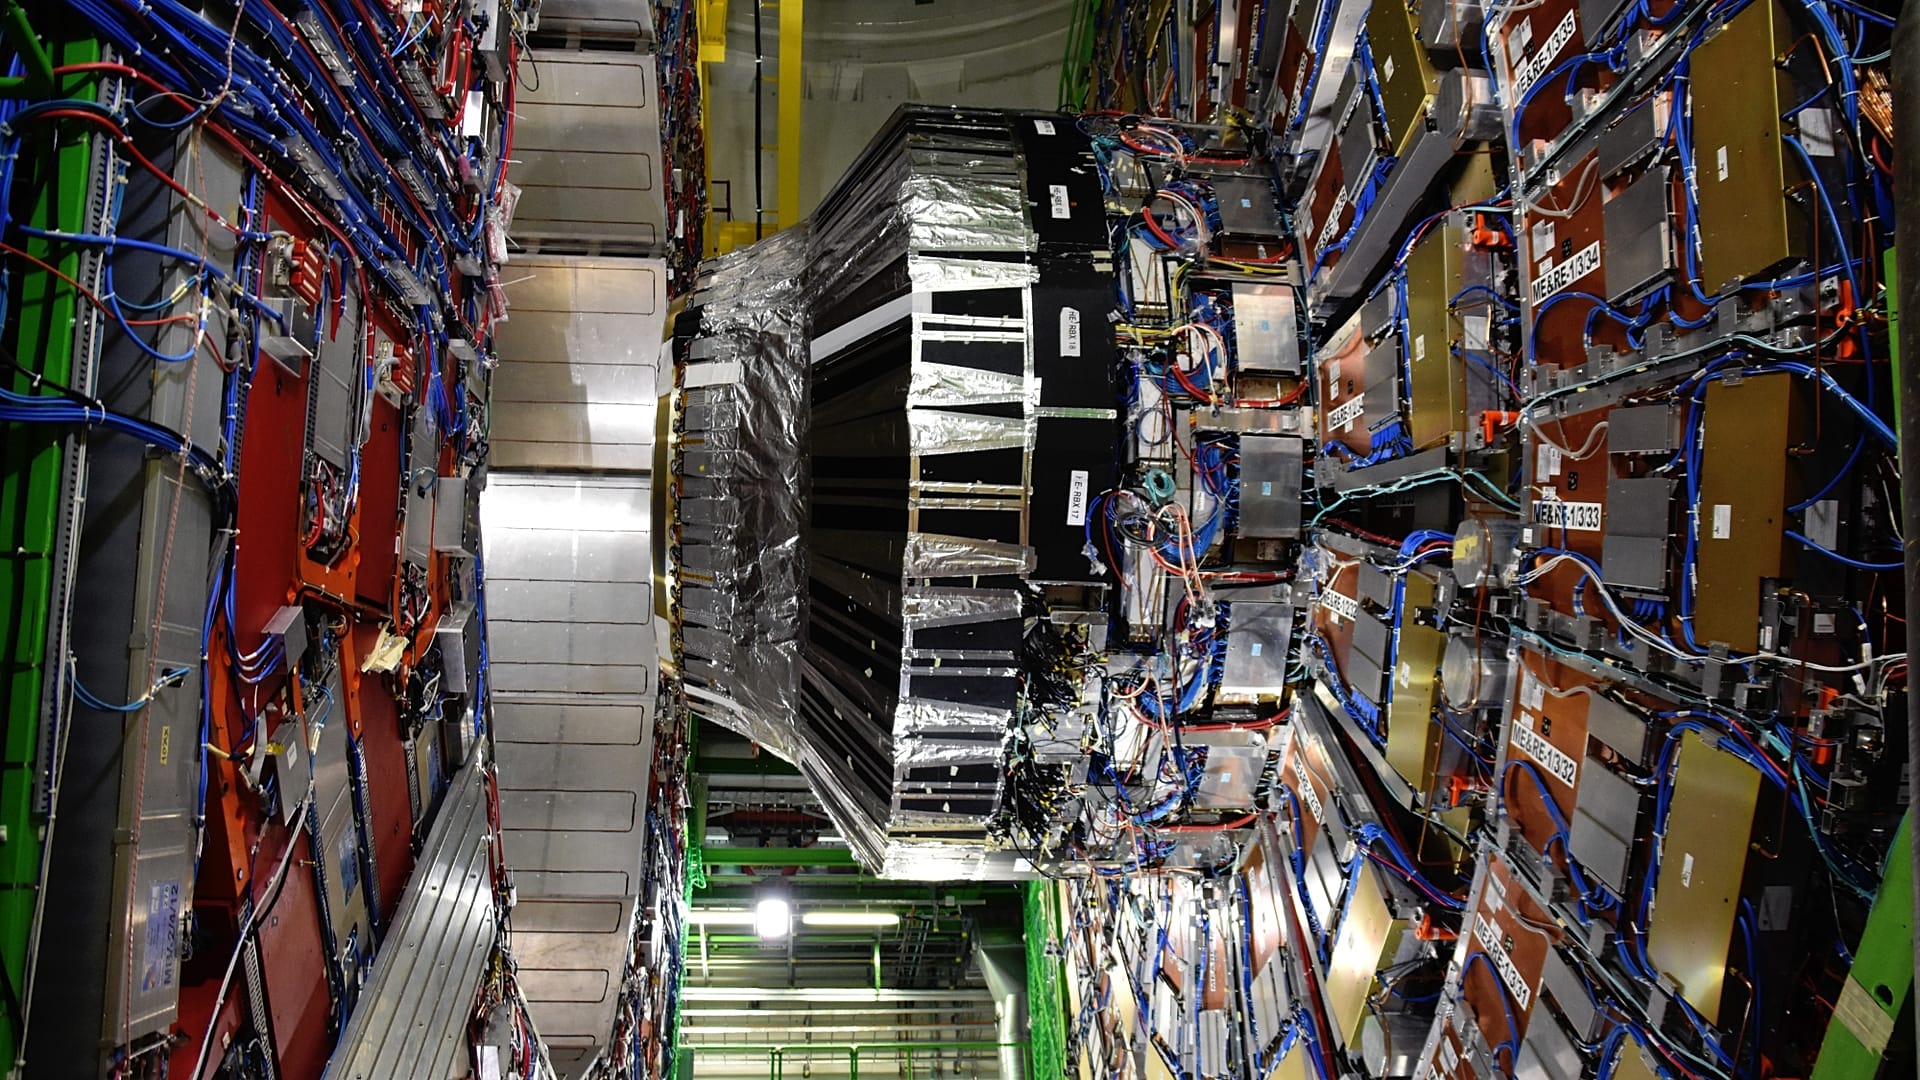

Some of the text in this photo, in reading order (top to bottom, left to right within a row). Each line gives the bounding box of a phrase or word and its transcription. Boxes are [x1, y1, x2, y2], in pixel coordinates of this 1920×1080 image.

[1513, 14, 1575, 103] ME&RE-1/3/35
[1532, 244, 1600, 303] ME&RE-1/3/34
[1068, 324, 1077, 339] RBX
[1071, 511, 1080, 519] 17
[1072, 491, 1082, 508] RBX
[1512, 723, 1576, 784] ME&RE-1/3/32
[1475, 916, 1529, 1006] ME&RE-1/3/31
